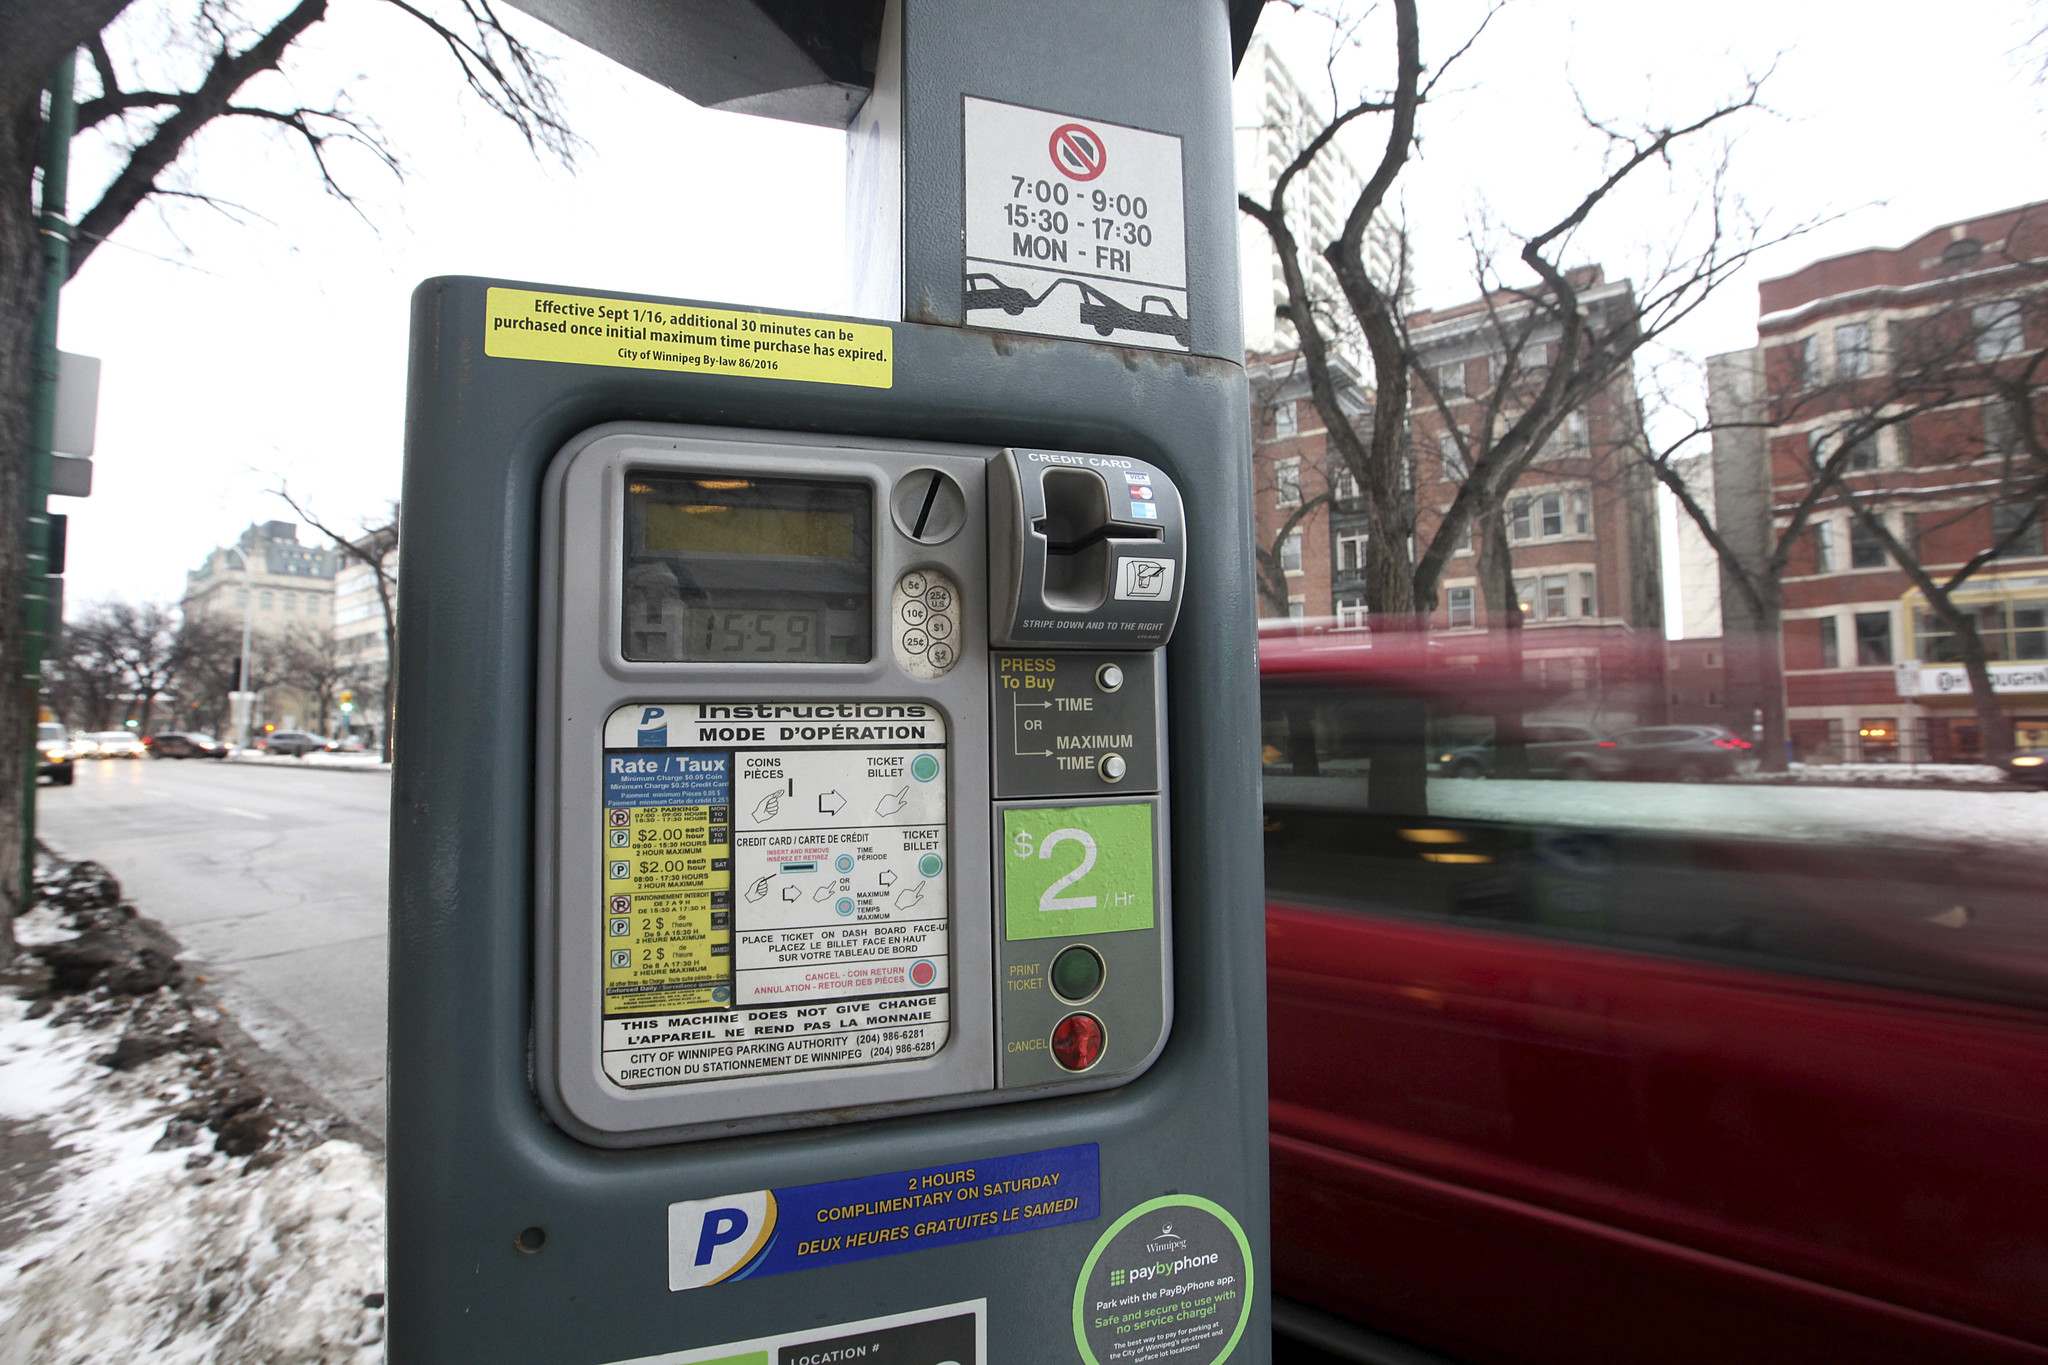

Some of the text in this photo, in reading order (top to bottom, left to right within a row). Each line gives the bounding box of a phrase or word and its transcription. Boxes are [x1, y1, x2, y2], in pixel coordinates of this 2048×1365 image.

[1012, 176, 1147, 219] 7:00 9:00
[1004, 204, 1151, 247] 15:30 17:30
[1013, 232, 1130, 272] MON FRI
[535, 300, 853, 341] Effective Sept 1/16, additional 30 minutes can be
[494, 318, 886, 362] purchased once initial maximum time purchase has expired.
[618, 348, 778, 370] City of Winnipeg By-law 86/2016
[1029, 454, 1132, 469] CREDIT CARD
[907, 610, 923, 619] 10¢
[1023, 620, 1054, 628] STRIPE
[706, 614, 809, 652] 15:59
[907, 638, 924, 646] 25¢
[1001, 659, 1055, 672] PRESS
[1001, 675, 1055, 691] To Buy
[700, 704, 926, 718] Instructions
[1055, 698, 1093, 711] TIME
[700, 724, 925, 741] MODE D'OPÉRATION
[1024, 720, 1042, 730] OR
[1057, 735, 1132, 749] MAXIMUM
[610, 758, 658, 774] Rate
[676, 757, 725, 772] Taux
[747, 758, 780, 767] COINS
[867, 757, 904, 766] TICKET
[1057, 756, 1094, 770] TIME
[744, 768, 783, 779] PIÈCES
[868, 768, 904, 777] BILLET
[638, 829, 682, 842] $2.00
[736, 838, 766, 847] CREDIT
[769, 837, 792, 845] CARD
[799, 835, 825, 844] CARTE
[828, 835, 838, 843] DE
[841, 833, 868, 842] CRÉDIT
[903, 830, 939, 839] TICKET
[904, 841, 939, 851] BILLET
[640, 860, 684, 874] $2.00
[742, 935, 773, 944] PLACE
[781, 933, 814, 942] TICKET
[843, 929, 867, 937] DASH
[875, 927, 906, 935] BOARD
[769, 943, 805, 952] PLACEZ
[827, 939, 857, 948] BILLET
[863, 937, 886, 945] FACE
[903, 935, 926, 943] HAUT
[779, 954, 798, 962] SUR
[800, 951, 831, 960] VOTRE
[834, 948, 875, 957] TABLEAU
[893, 945, 917, 953] BORD
[1010, 964, 1040, 976] PRINT
[1008, 978, 1043, 990] TICKET
[621, 997, 936, 1030] THIS MACHINE DOES NOT GIVE CHANGE
[628, 1012, 931, 1045] L'APPAREIL NE REND PAS LA MONNAIE
[631, 1029, 923, 1064] CITY OF WINNIPEG PARKING AUTHORITY (204) 986-6281
[1008, 1039, 1048, 1052] CANCEL
[621, 1041, 935, 1080] DIRECTION DU STATIONNEMENT DE WINNIPEG (204) 986-6281
[909, 1169, 975, 1190] 2 HOURS
[817, 1173, 1059, 1222] COMPLIMENTARY ON SATURDAY
[798, 1197, 1078, 1255] DEUX HEURES GRATUITES LE SAMEDI
[694, 1207, 748, 1266] P
[1146, 1239, 1187, 1253] Winnipeg
[1130, 1253, 1218, 1283] paybyphone
[1097, 1276, 1235, 1310] Park with the PayByPhone app.
[1095, 1290, 1235, 1328] Safe and secure to use with
[1117, 1304, 1216, 1334] no service charge!
[791, 1346, 866, 1365] LOCATION
